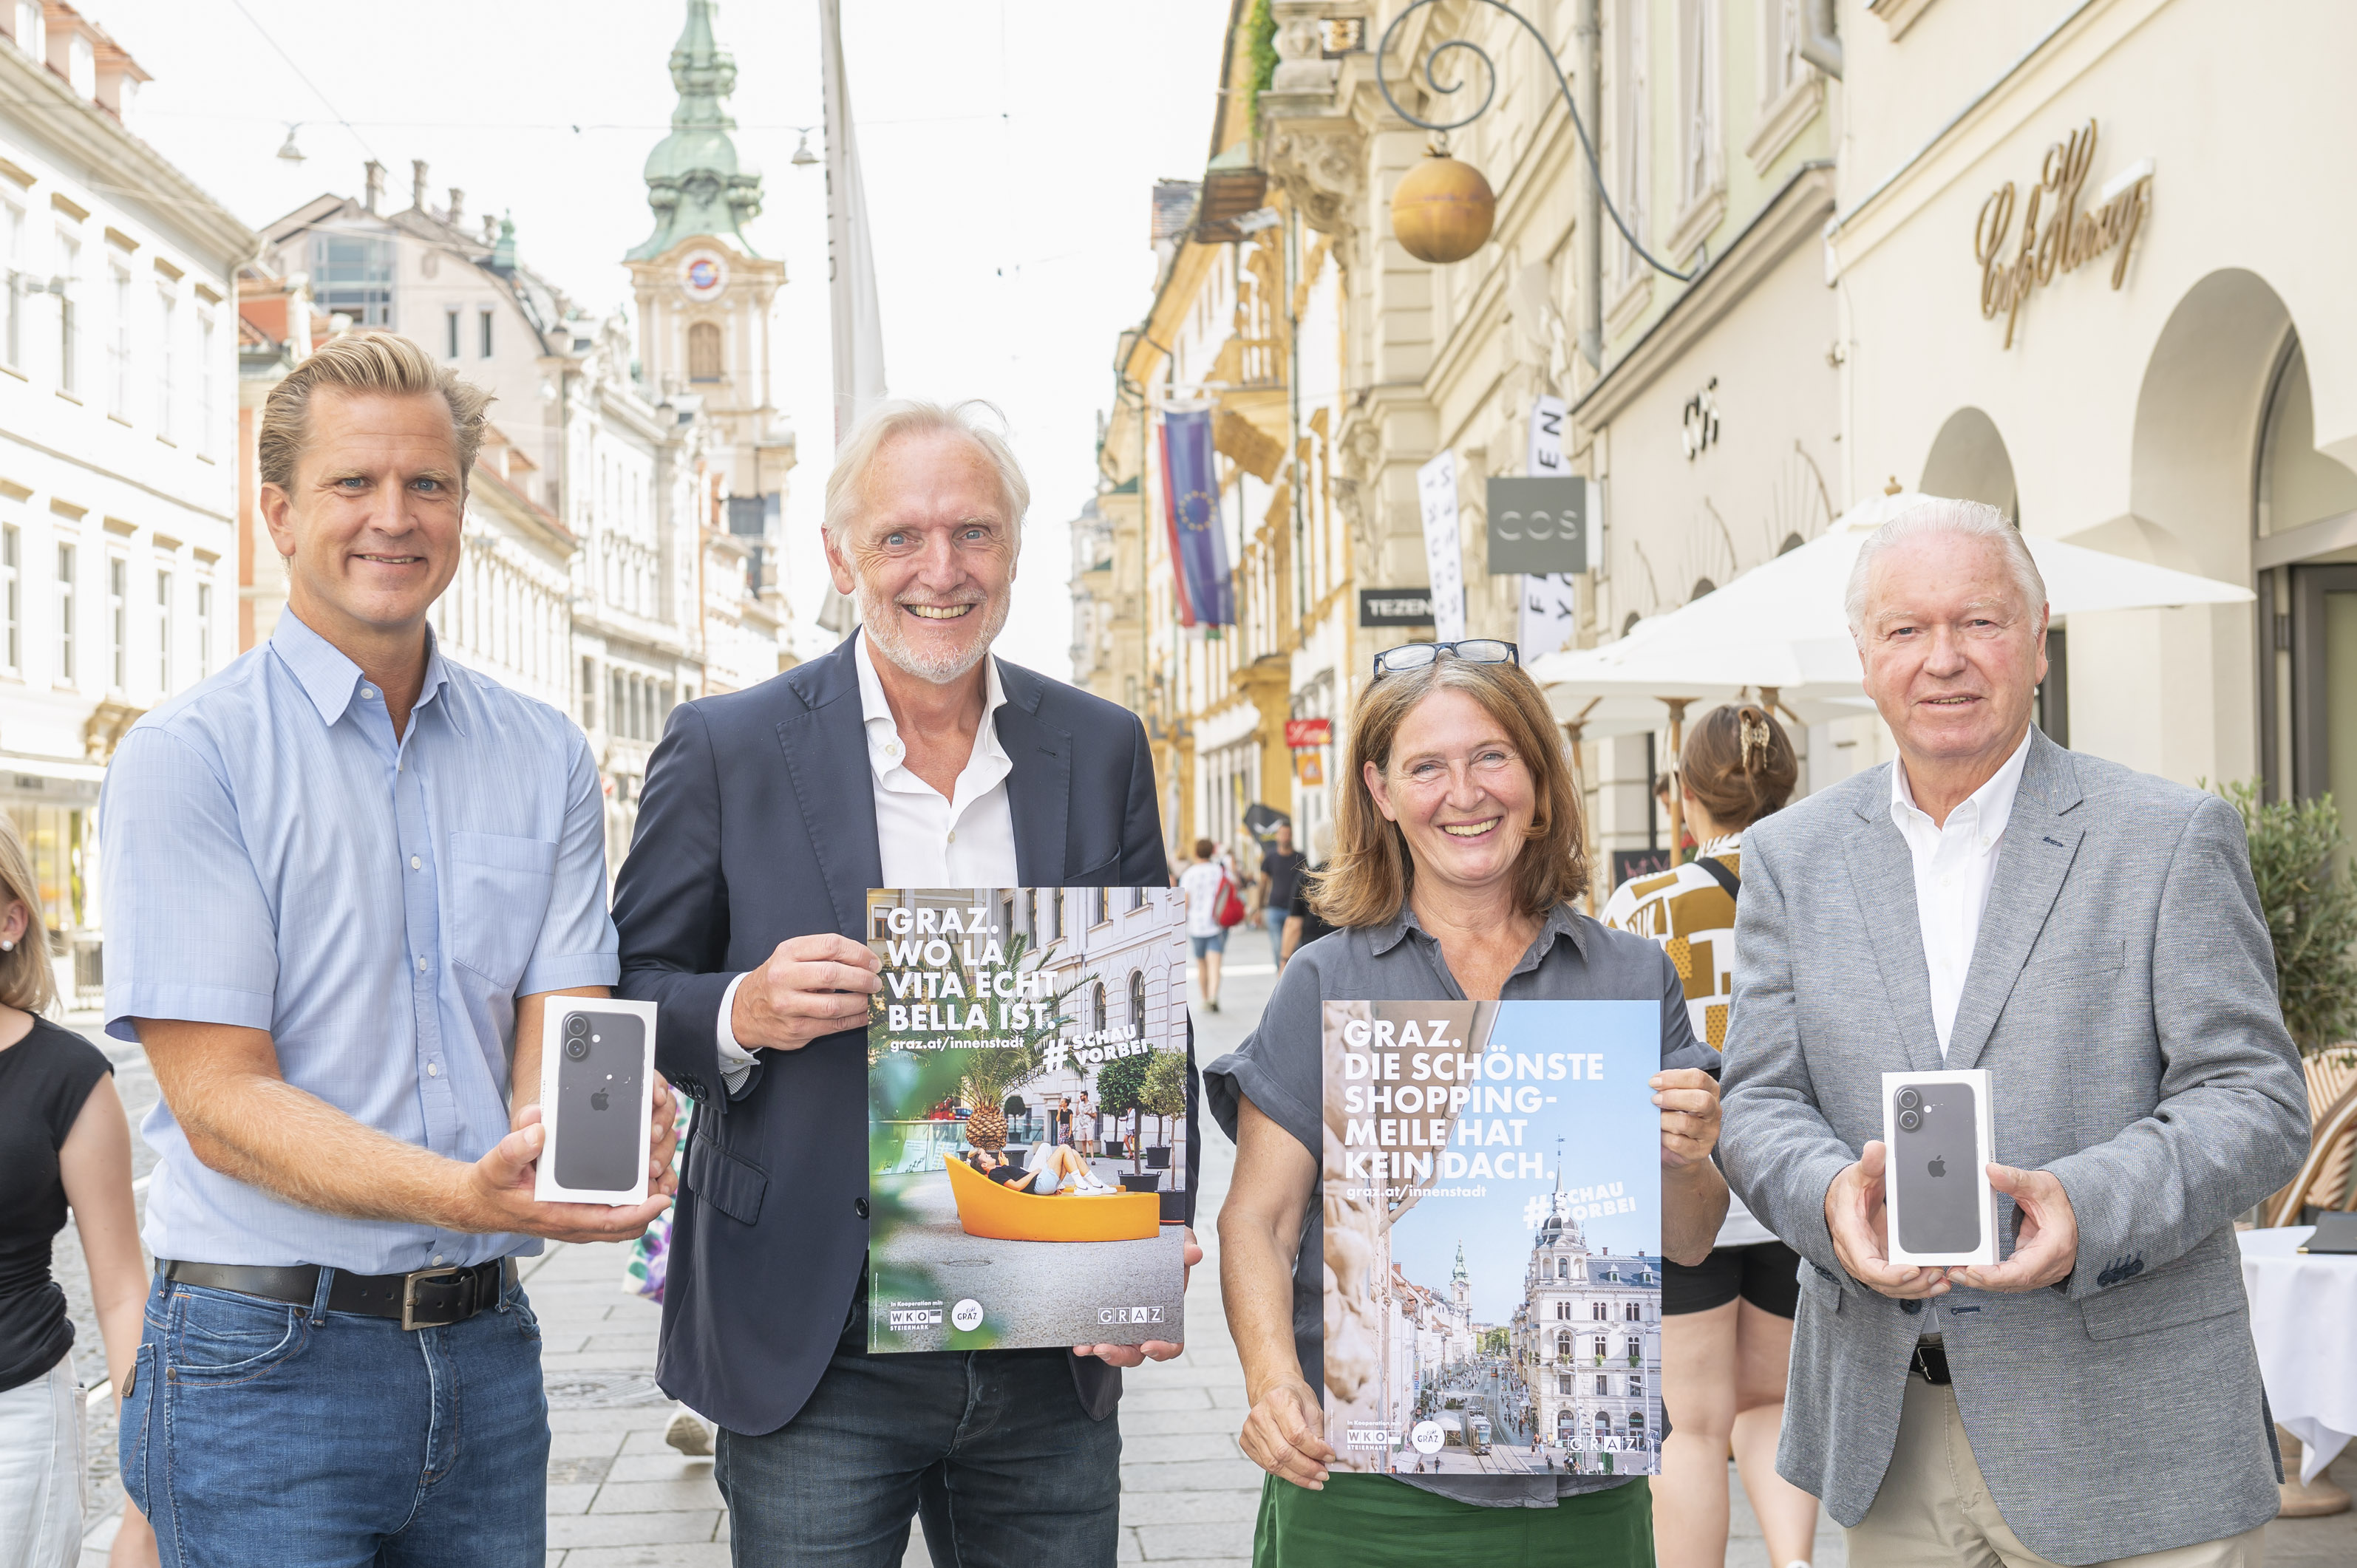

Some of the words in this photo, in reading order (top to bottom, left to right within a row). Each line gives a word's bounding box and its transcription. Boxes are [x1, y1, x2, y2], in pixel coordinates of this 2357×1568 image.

[1496, 509, 1579, 541] COS
[1367, 598, 1435, 616] TEZEN
[887, 907, 999, 935] GRAZ.
[886, 939, 953, 967] WO
[962, 939, 1006, 967] LA
[886, 971, 966, 999] VITA
[976, 970, 1058, 998] ECHT
[888, 1003, 990, 1032] BELLA
[1000, 1003, 1056, 1031] IST.
[890, 1035, 1024, 1053] graz.at/innenstadt
[1344, 1020, 1462, 1047] GRAZ.
[1073, 1038, 1149, 1066] VORBEI
[1344, 1053, 1401, 1080] DIE
[1411, 1044, 1604, 1080] SCHÖNSTE
[1344, 1085, 1557, 1114] SHOPPING-
[1344, 1119, 1446, 1146] MEILE
[1458, 1119, 1528, 1146] HAT
[1344, 1151, 1431, 1179] KEIN
[1444, 1151, 1555, 1180] DACH.
[1346, 1184, 1487, 1200] graz.at/innenstadt
[1557, 1196, 1637, 1223] VORBEI
[891, 1311, 928, 1323] WKO
[957, 1312, 977, 1320] GRAZ
[1099, 1307, 1163, 1323] GRAZ
[1348, 1431, 1387, 1443] WKO
[1418, 1435, 1438, 1443] GRAZ
[1569, 1436, 1637, 1452] GRAZ
